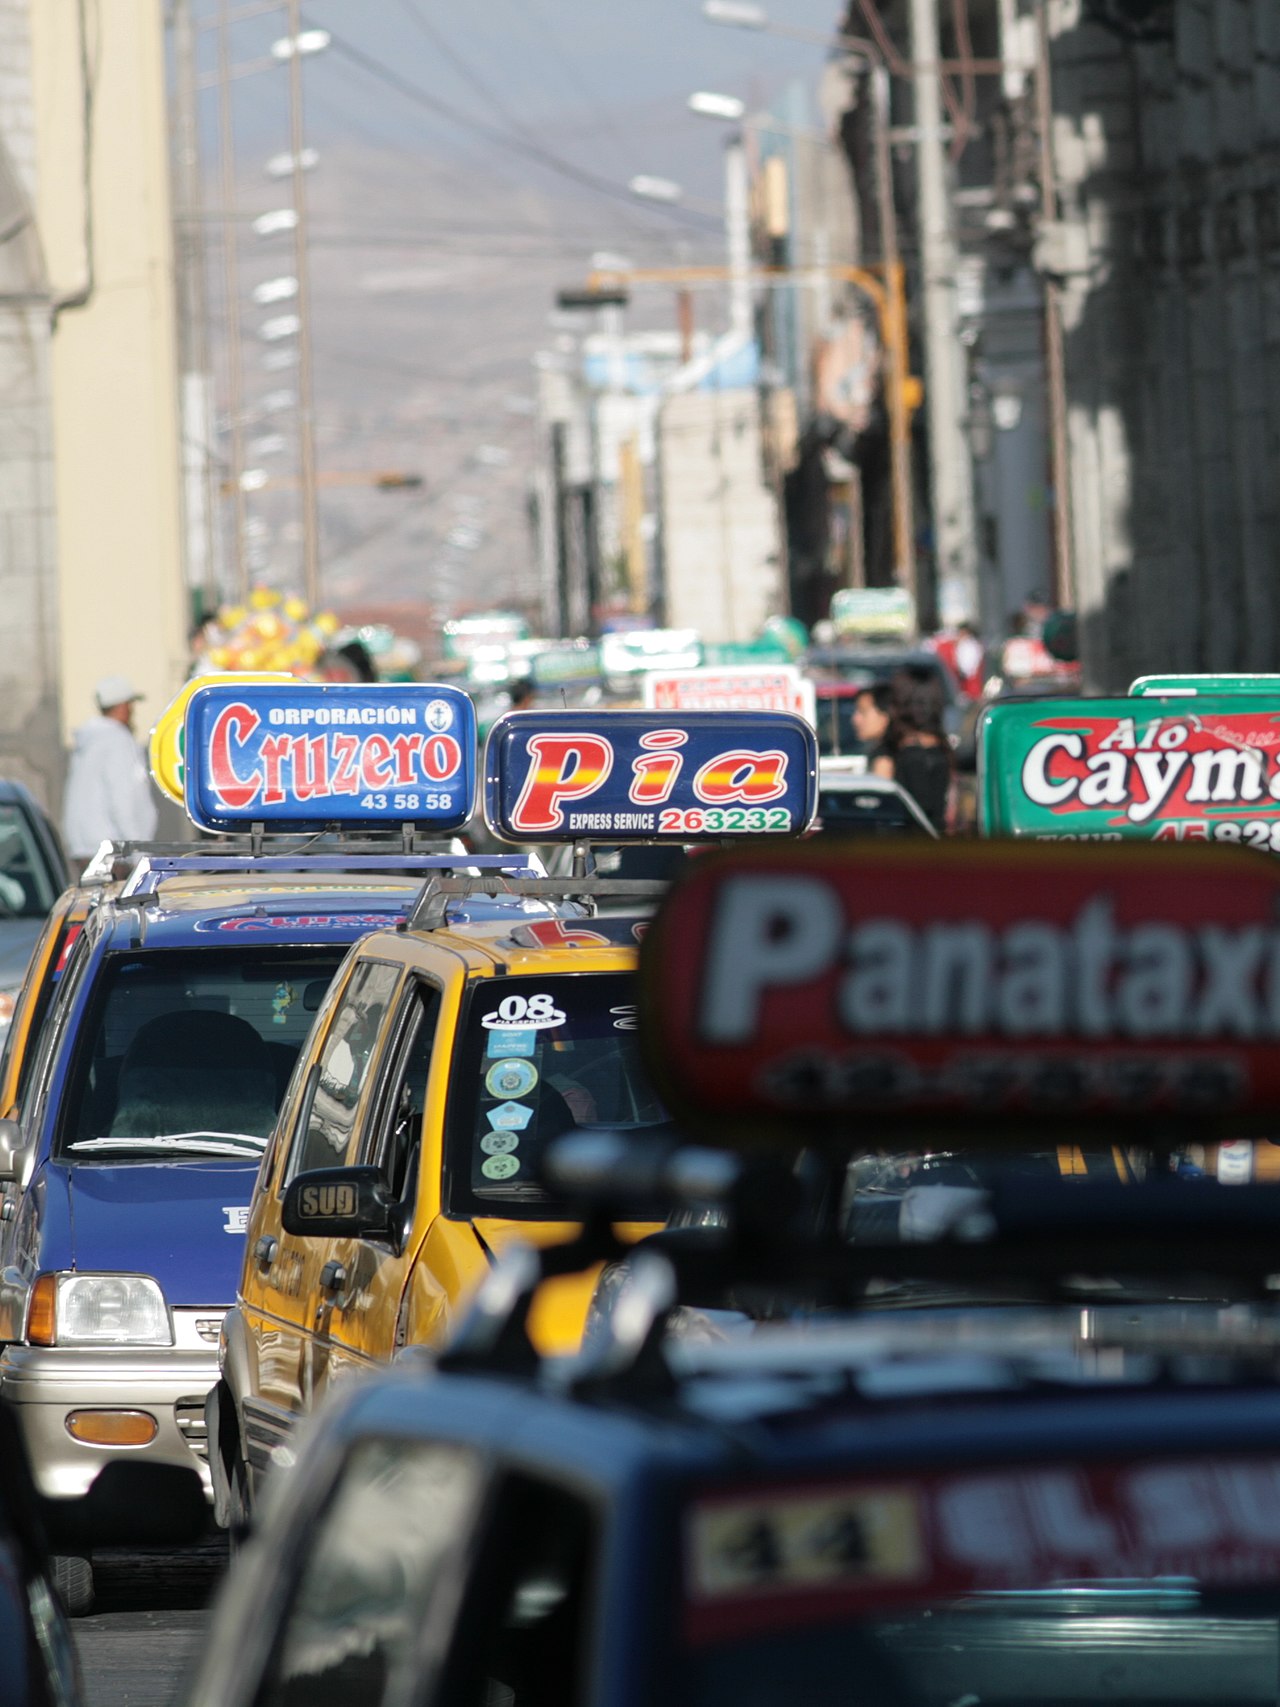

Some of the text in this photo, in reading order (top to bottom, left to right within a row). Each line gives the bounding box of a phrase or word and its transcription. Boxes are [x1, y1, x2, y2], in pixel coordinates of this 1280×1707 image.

[268, 706, 417, 725] ORPORACIÓN
[1098, 718, 1189, 750] Alo
[208, 702, 462, 808] Cruzero
[511, 729, 788, 832] Pia
[361, 794, 452, 809] 43 58 58
[570, 813, 654, 829] EXPRESS SERVICE
[658, 807, 791, 833] 263232
[499, 994, 554, 1020] 08
[303, 1186, 354, 1215] SUD
